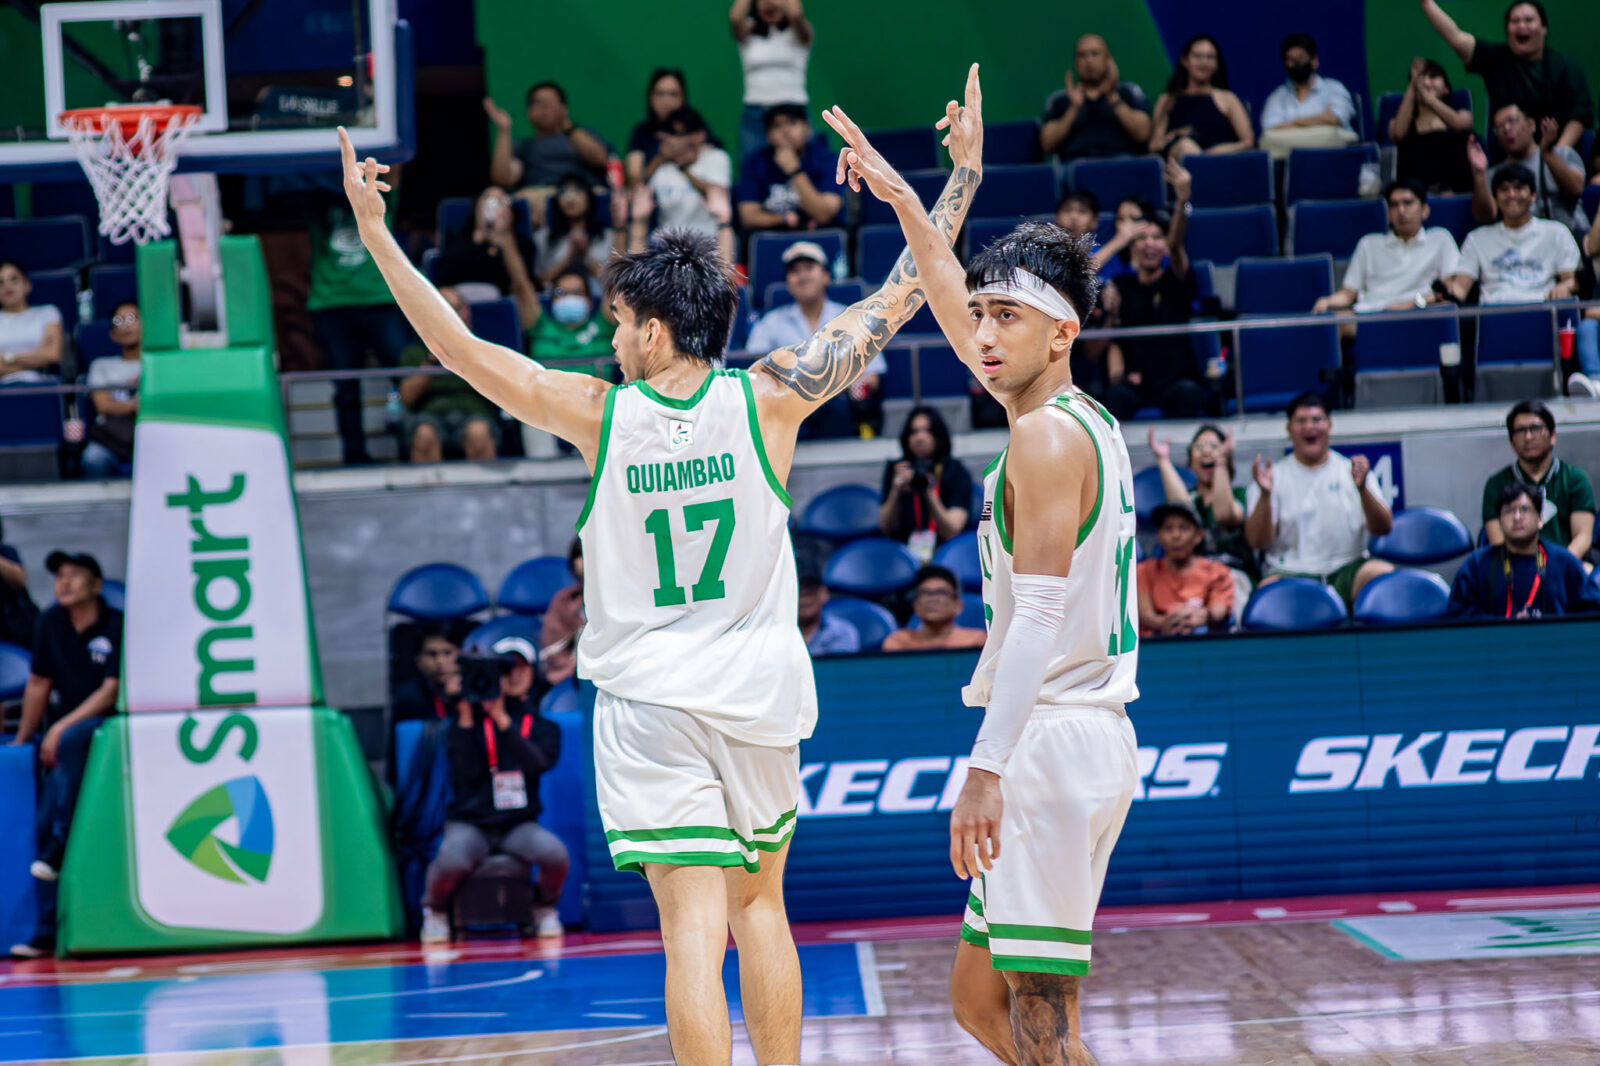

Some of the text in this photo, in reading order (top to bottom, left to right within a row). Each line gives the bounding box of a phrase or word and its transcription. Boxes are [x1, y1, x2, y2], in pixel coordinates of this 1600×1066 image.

[626, 452, 736, 494] QUIAMBAO
[644, 498, 736, 607] 17
[165, 472, 258, 764] Smart
